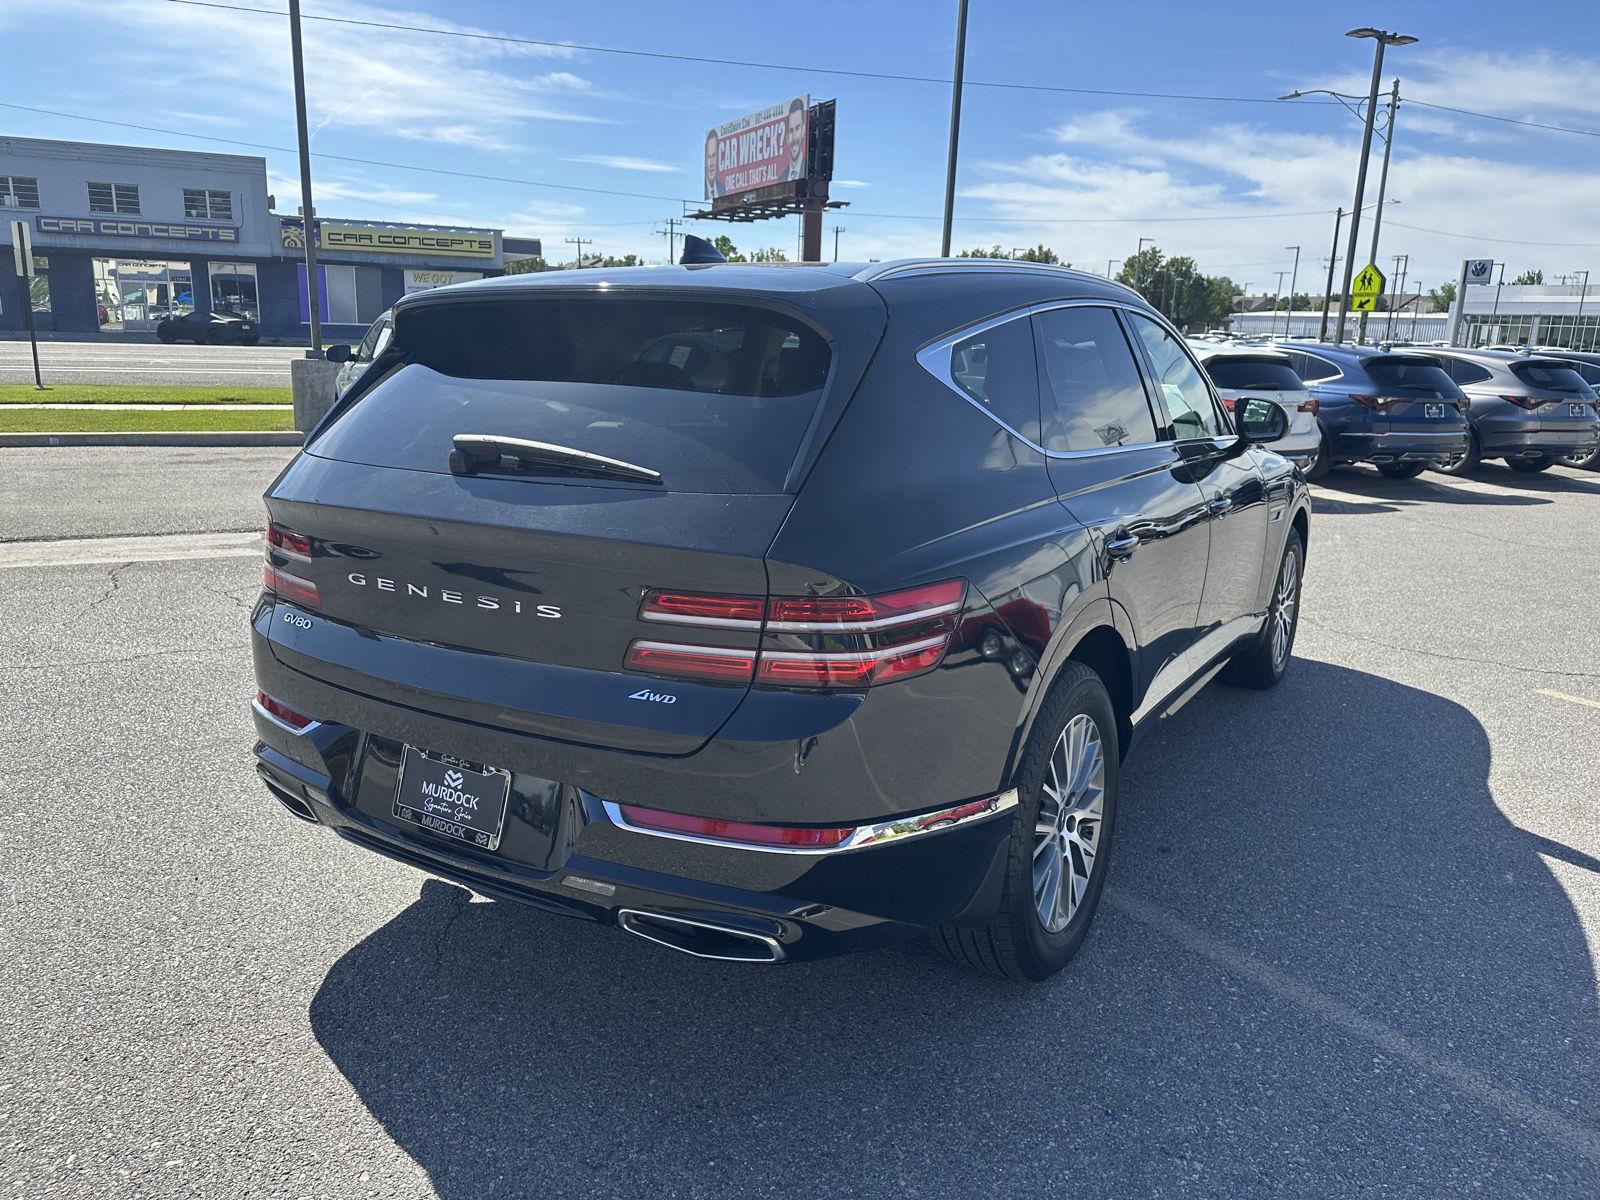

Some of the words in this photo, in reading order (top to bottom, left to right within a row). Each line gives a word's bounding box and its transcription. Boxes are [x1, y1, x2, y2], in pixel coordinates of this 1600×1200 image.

[718, 138, 737, 172] CAR
[739, 121, 786, 166] WRECK?
[725, 174, 735, 191] ONE
[736, 171, 748, 188] CALL
[40, 218, 95, 233] CAR
[99, 221, 236, 241] CONCEPTS
[327, 232, 374, 244] CAR
[378, 234, 492, 250] CONCEPTS
[413, 272, 430, 283] WE
[432, 272, 454, 284] GOT
[347, 572, 563, 619] GENESIS
[284, 612, 311, 629] GV80
[421, 781, 480, 810] MURDOCK
[424, 797, 452, 814] Signature
[454, 806, 472, 822] Series
[421, 814, 467, 838] MURDOCK
